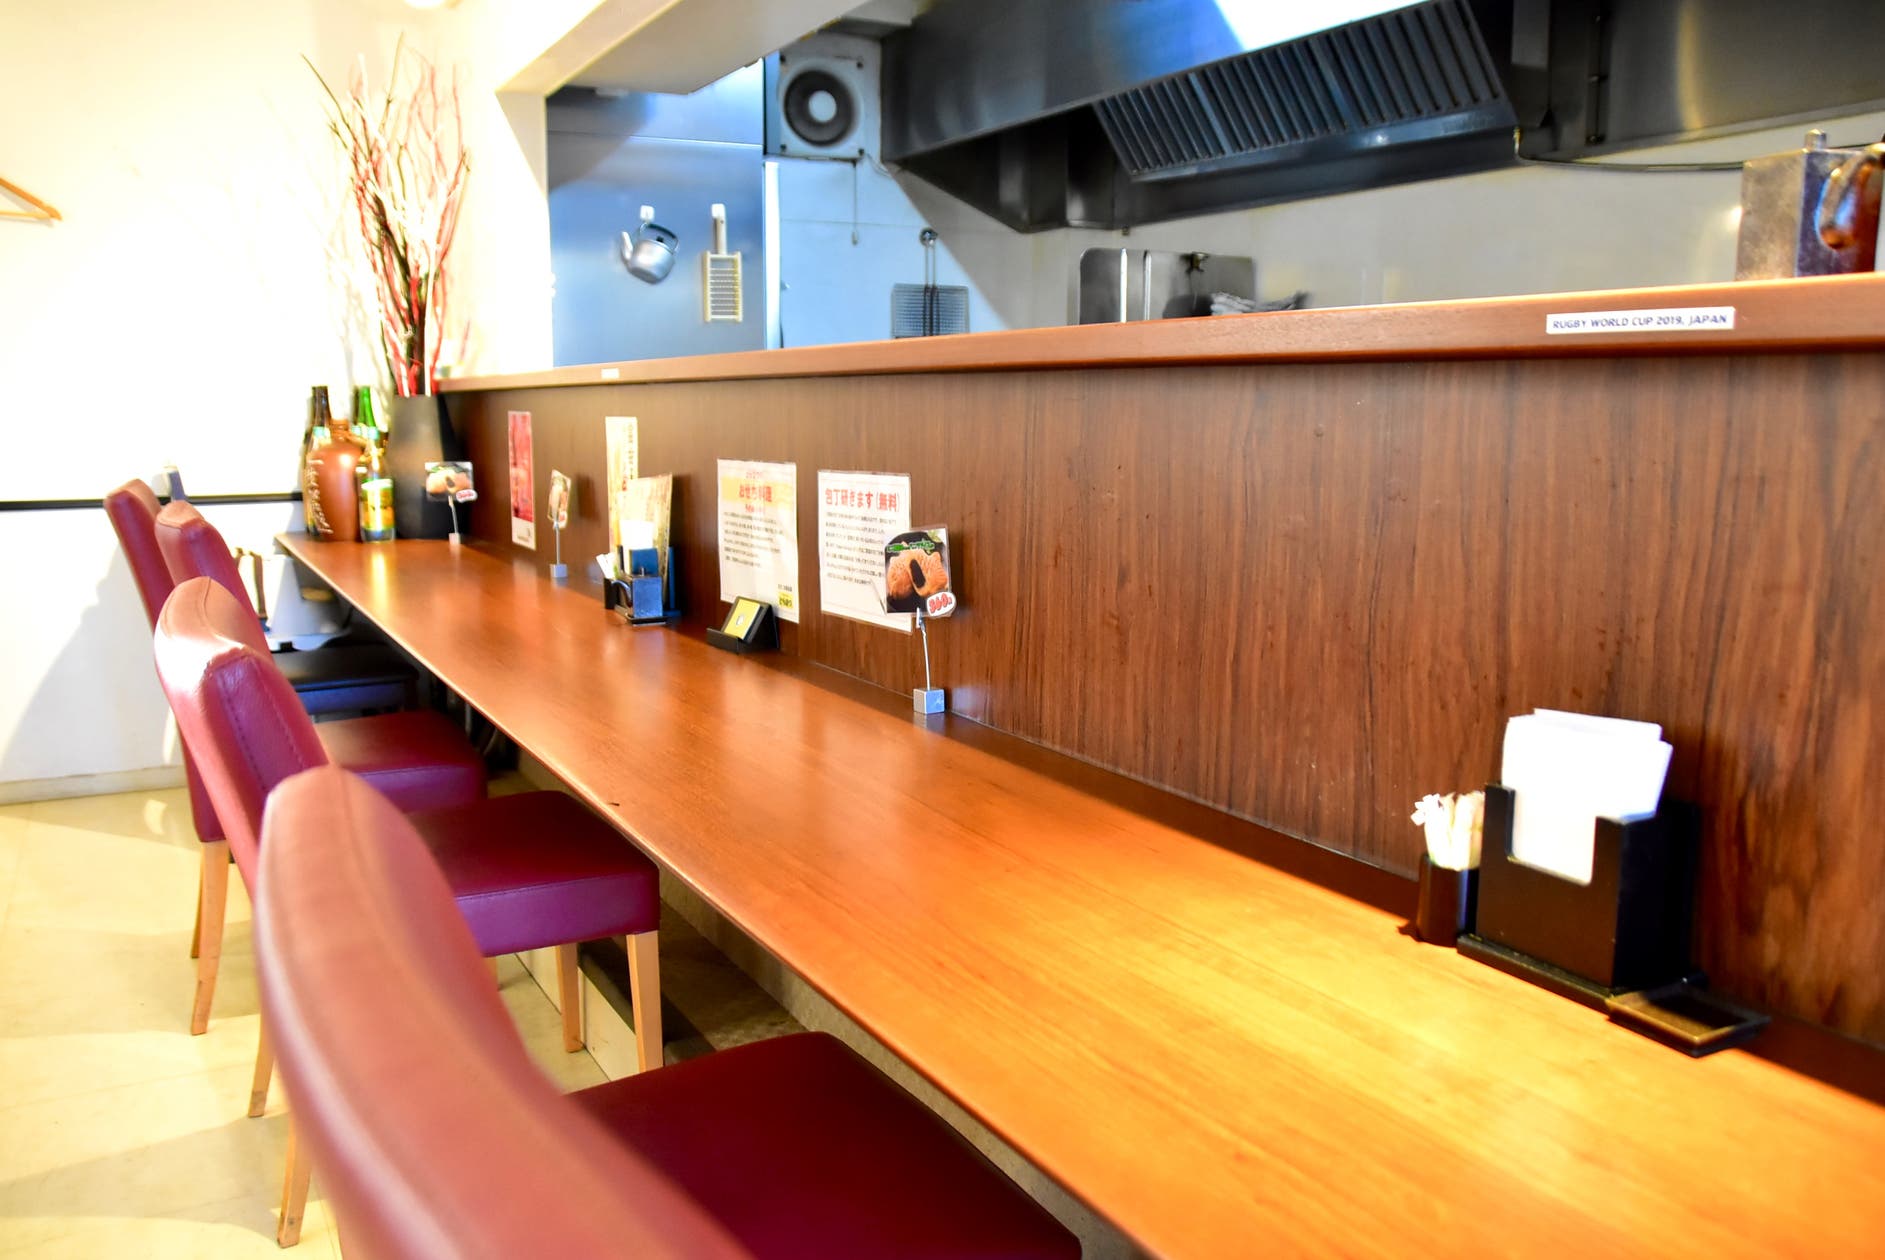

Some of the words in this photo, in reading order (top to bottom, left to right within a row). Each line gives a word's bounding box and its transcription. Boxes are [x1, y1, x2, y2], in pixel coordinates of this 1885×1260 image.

[1552, 320, 1586, 329] RUGBY
[1591, 317, 1629, 328] WORLD
[1632, 316, 1653, 327] CUP
[1688, 313, 1728, 326] JAPAN
